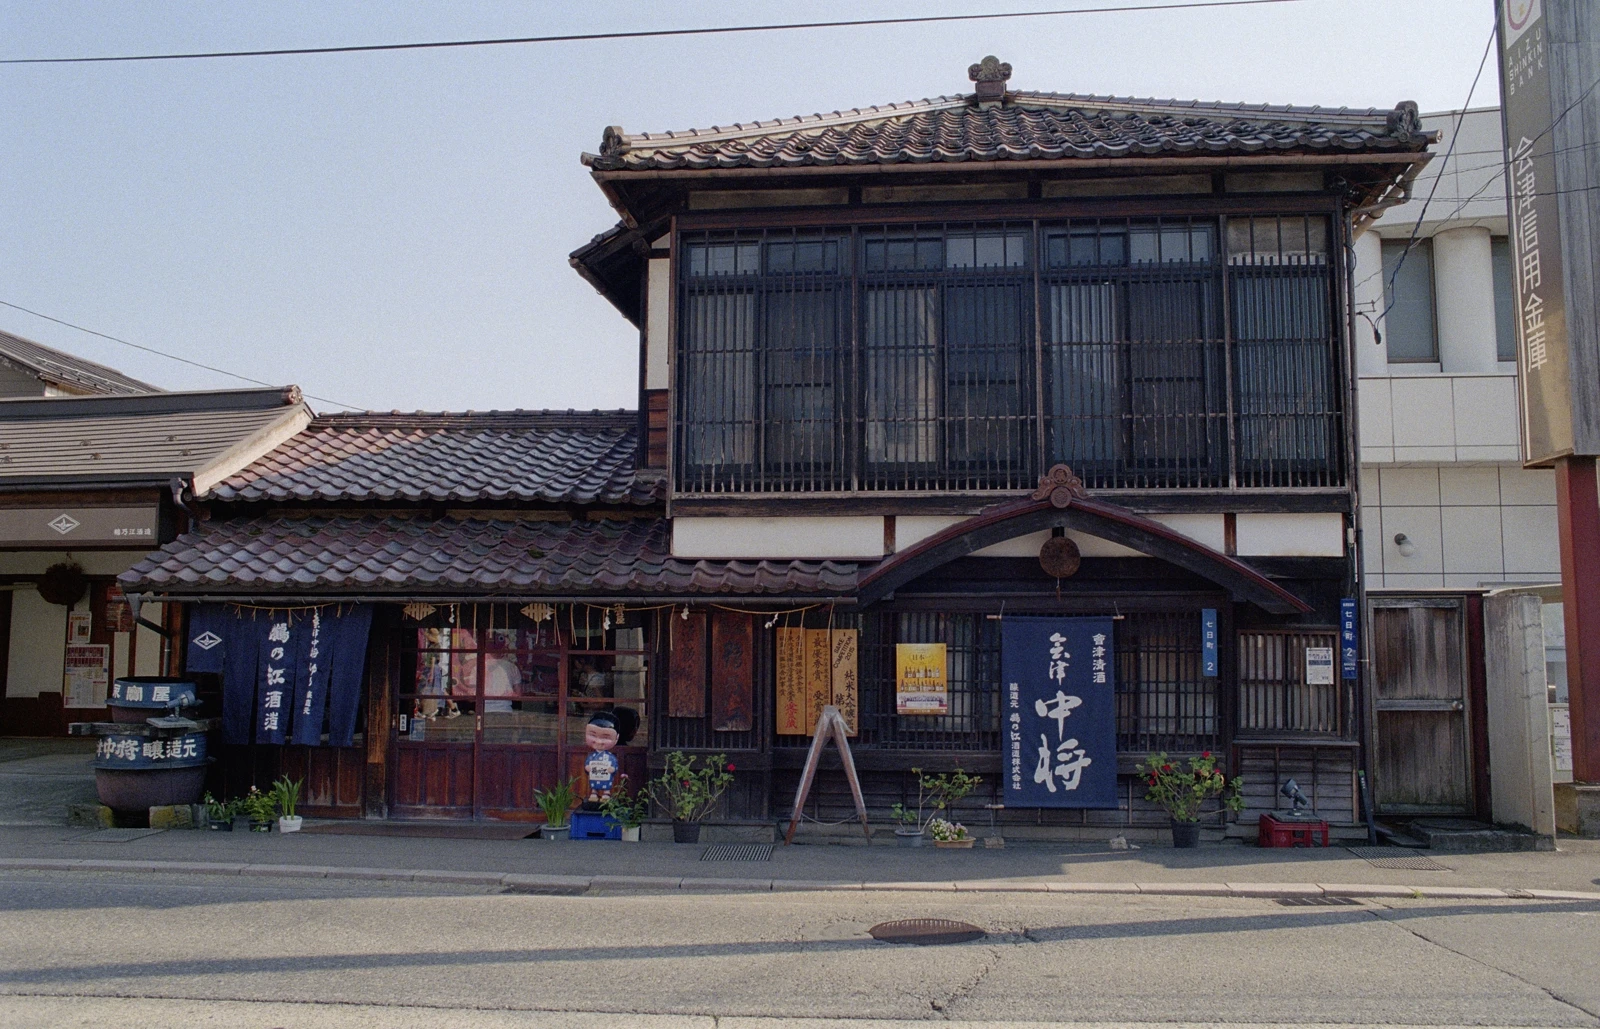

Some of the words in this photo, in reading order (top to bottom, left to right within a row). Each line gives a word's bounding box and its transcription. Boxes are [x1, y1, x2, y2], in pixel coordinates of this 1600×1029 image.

[1509, 27, 1542, 68] AIZU
[1510, 42, 1542, 81] SHINKIN
[1510, 56, 1543, 96] BANK
[1514, 136, 1547, 373] 会津信用金庫
[1206, 621, 1215, 649] 七日町
[1345, 611, 1353, 641] 七日町
[812, 637, 823, 682] 最優秀賞
[833, 637, 845, 654] SAKE
[833, 635, 853, 669] COMPETITION
[845, 647, 855, 661] 2015
[1346, 647, 1353, 657] 2
[1207, 661, 1214, 671] 2
